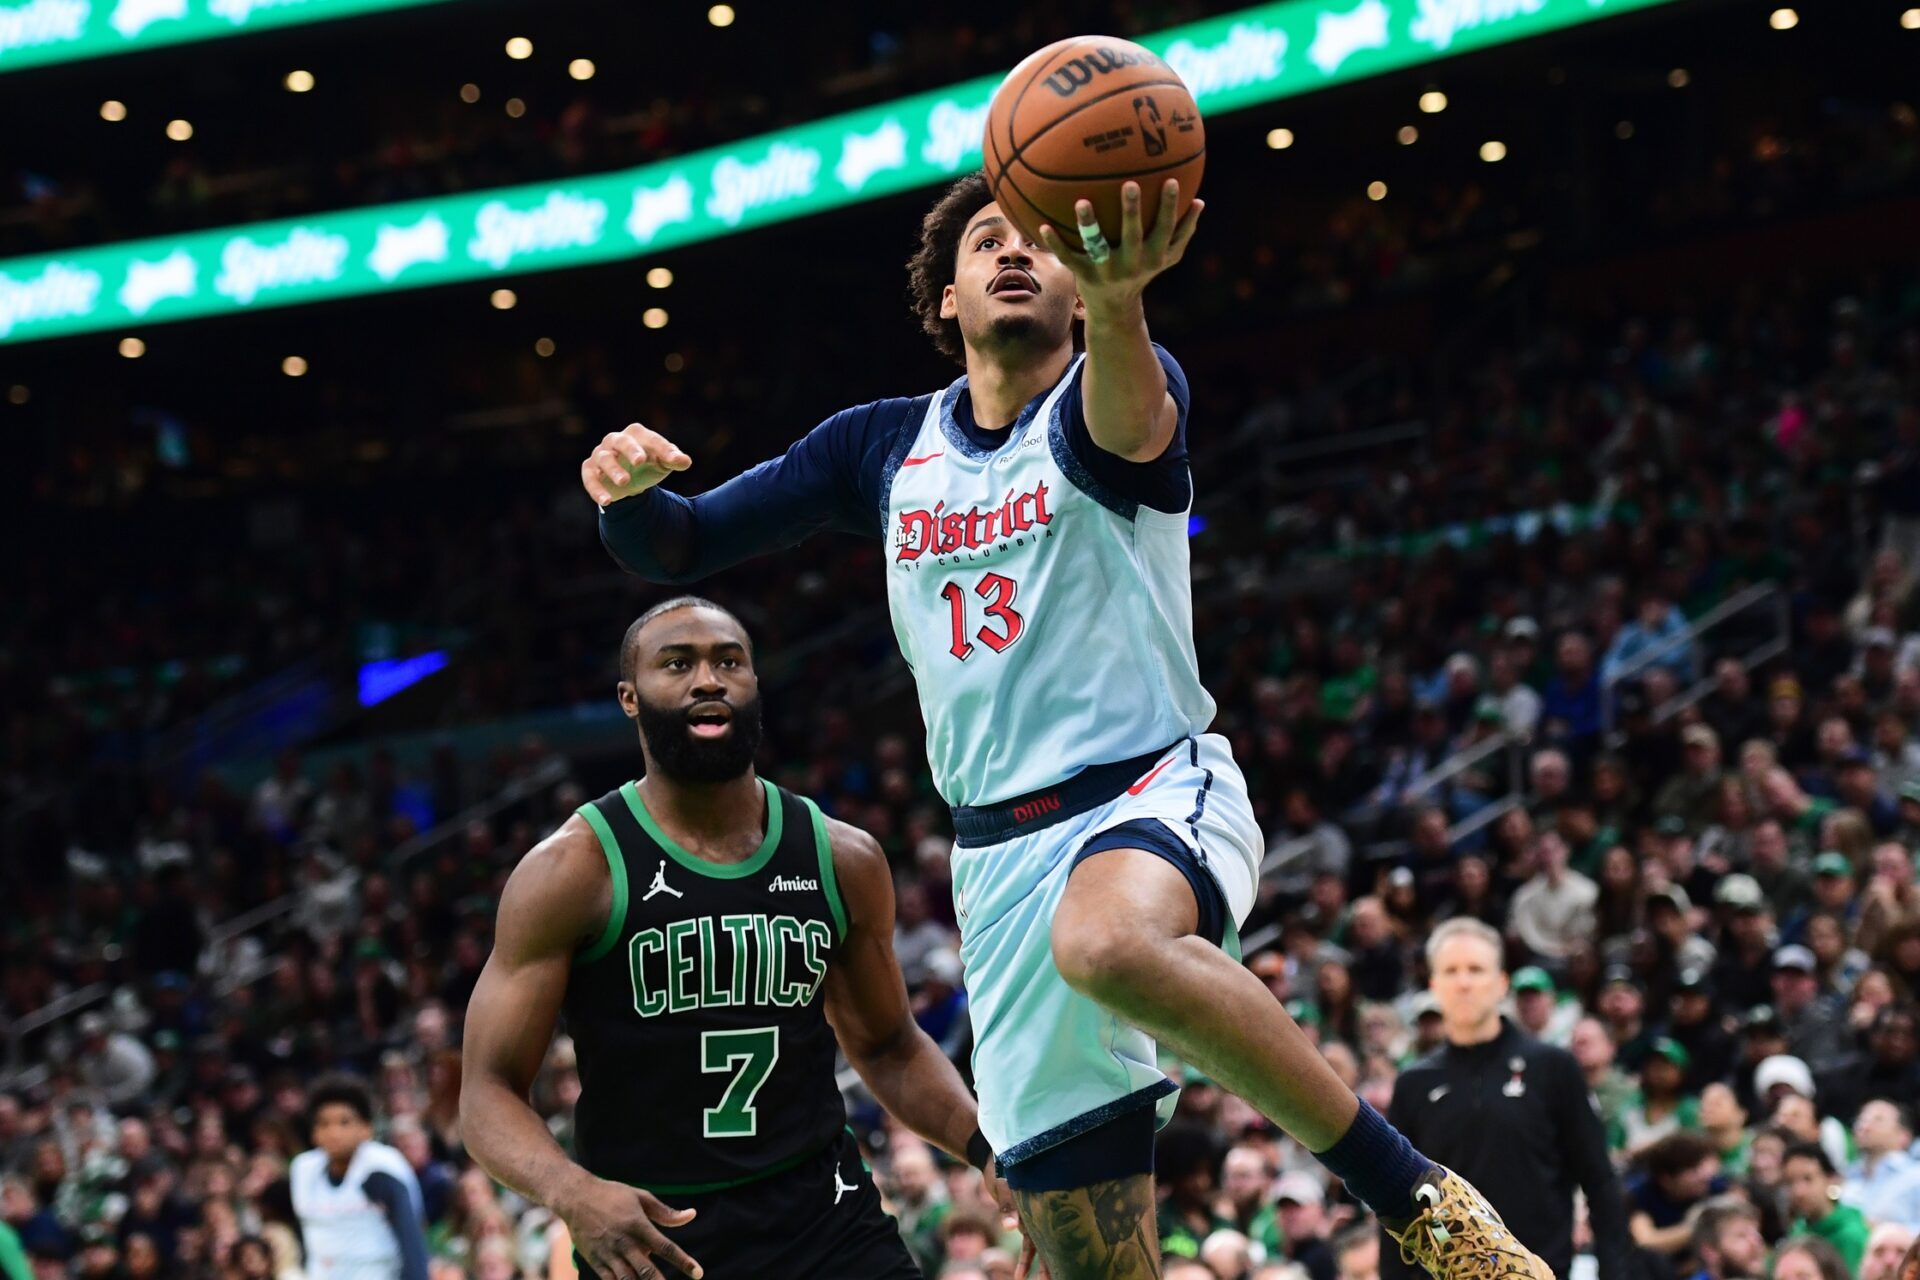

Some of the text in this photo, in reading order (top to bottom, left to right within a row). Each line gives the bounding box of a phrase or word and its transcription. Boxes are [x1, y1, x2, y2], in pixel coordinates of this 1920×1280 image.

[896, 479, 1054, 564] District
[938, 529, 1053, 566] COLUMBIA
[941, 571, 1025, 662] 13
[768, 874, 818, 893] Amica
[629, 913, 831, 1018] CELTICS
[701, 1026, 779, 1138] 7
